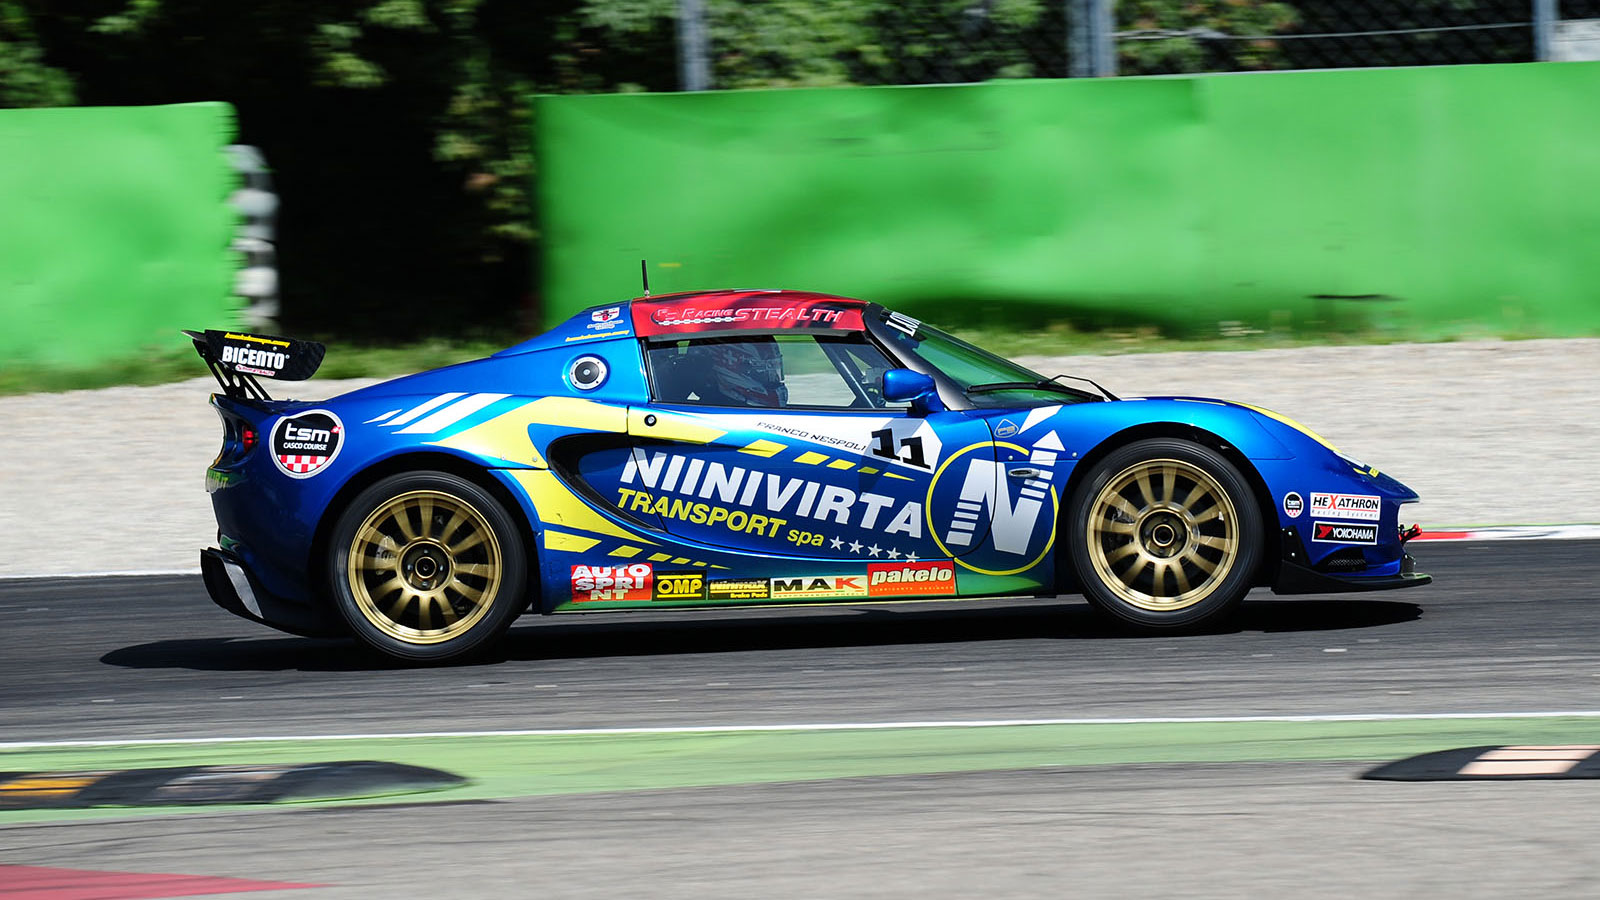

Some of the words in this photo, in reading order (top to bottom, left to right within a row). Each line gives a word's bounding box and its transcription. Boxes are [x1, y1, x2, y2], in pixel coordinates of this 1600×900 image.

[733, 307, 845, 323] STEALTH
[222, 345, 285, 370] BICENTO
[284, 422, 330, 443] tsm
[757, 421, 809, 438] FRANCO
[810, 434, 867, 451] NESPOLI
[283, 442, 301, 450] CASCO
[302, 442, 327, 451] COURSE
[871, 428, 931, 470] 11
[619, 447, 923, 539] NIINIVIRTA
[1313, 495, 1379, 510] HEXATHRON
[617, 488, 786, 539] TRANSPORT
[787, 528, 825, 548] spa
[1332, 527, 1374, 540] YOKOHAMA
[571, 564, 651, 579] AUTO
[871, 567, 953, 586] pakelo
[575, 576, 644, 591] SPRI
[657, 579, 702, 594] OMP
[774, 578, 863, 591] MAK
[590, 589, 629, 600] NT
